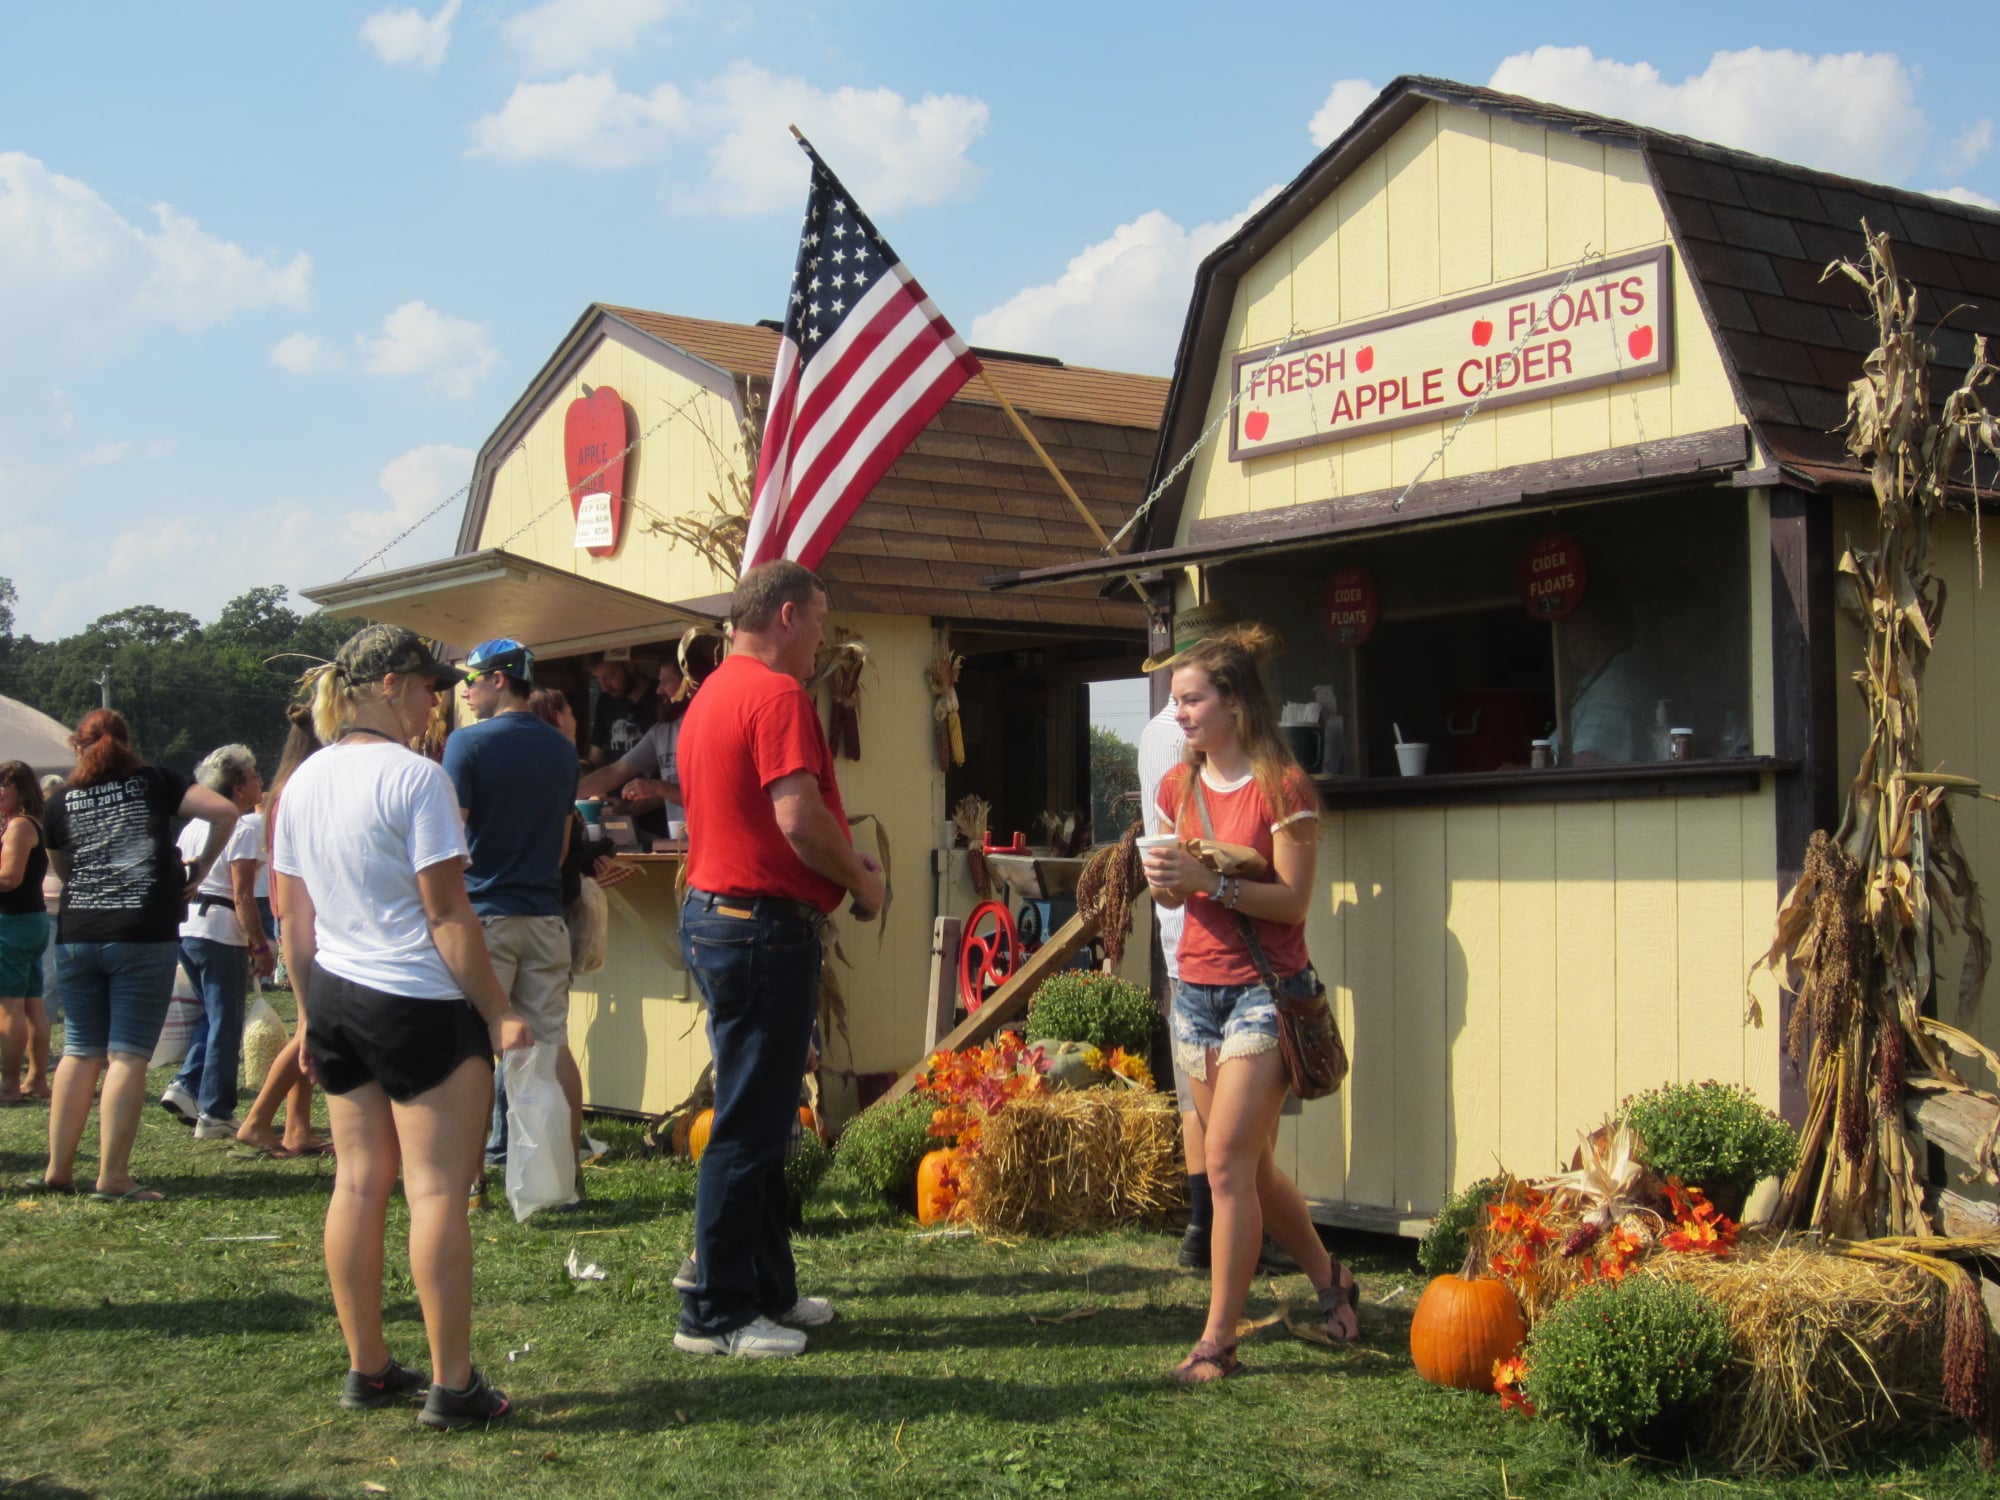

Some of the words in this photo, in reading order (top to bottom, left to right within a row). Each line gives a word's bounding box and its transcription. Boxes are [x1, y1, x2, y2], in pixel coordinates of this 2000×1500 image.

[1508, 276, 1645, 341] FLOATS
[1250, 348, 1346, 401] FRESH
[1330, 368, 1444, 425] APPLE
[1457, 339, 1573, 397] CIDER
[578, 442, 608, 465] APPLE
[1532, 552, 1567, 572] CIDER
[1335, 588, 1363, 602] CIDER
[1530, 573, 1575, 597] FLOATS
[1331, 610, 1367, 624] FLOATS
[65, 781, 122, 800] FESTIVAL
[65, 798, 95, 812] TOUR
